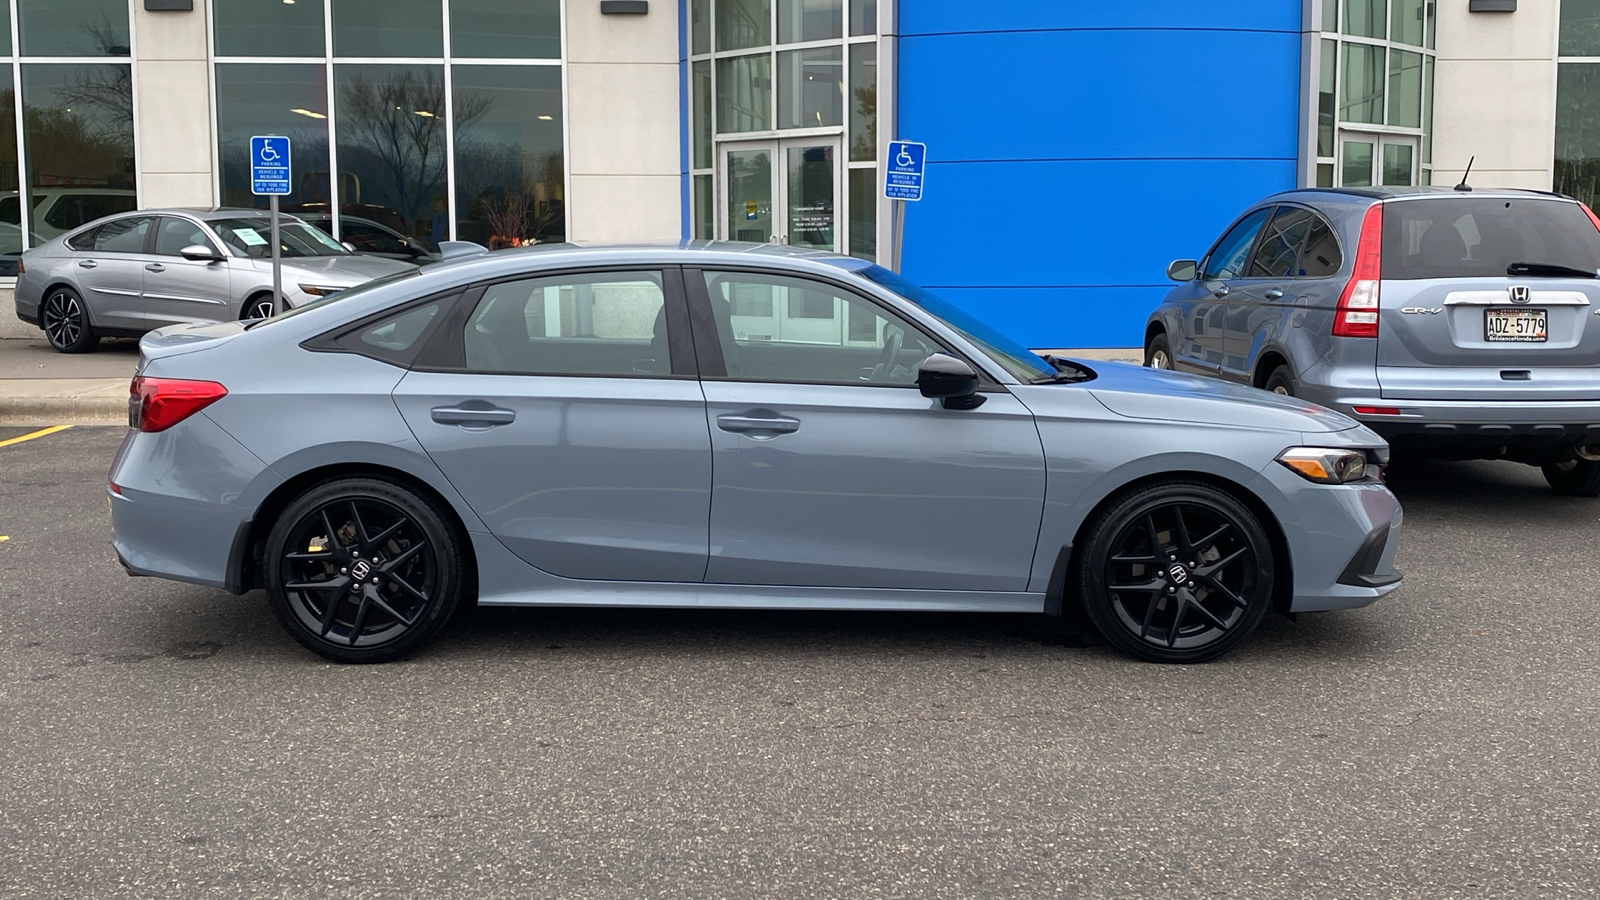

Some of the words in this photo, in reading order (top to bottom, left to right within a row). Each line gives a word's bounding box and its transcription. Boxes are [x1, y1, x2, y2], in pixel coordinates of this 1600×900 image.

[1400, 307, 1443, 315] CR-V
[1489, 318, 1545, 333] ADZ-5779
[340, 486, 416, 509] GOODYEAR
